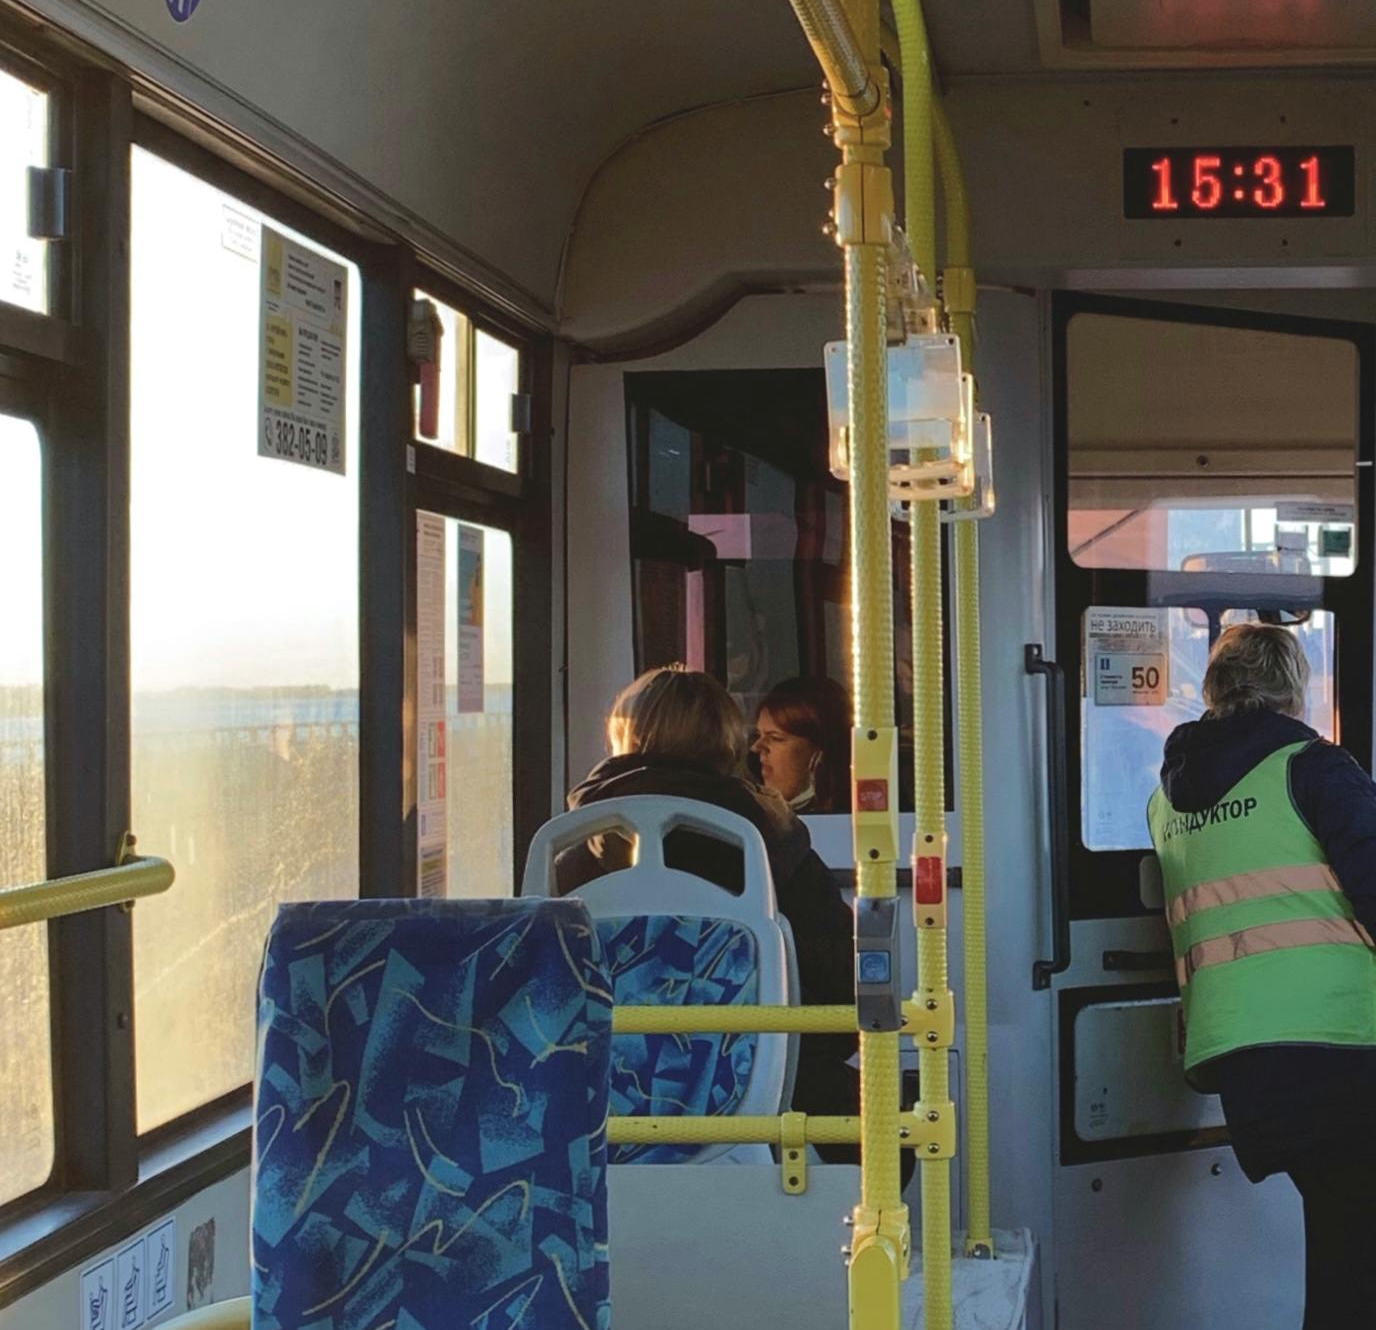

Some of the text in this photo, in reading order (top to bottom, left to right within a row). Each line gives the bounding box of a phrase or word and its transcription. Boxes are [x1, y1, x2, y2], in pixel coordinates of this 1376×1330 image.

[1151, 155, 1327, 209] 15:31
[275, 420, 328, 465] 382-05-09
[1131, 667, 1160, 689] 50
